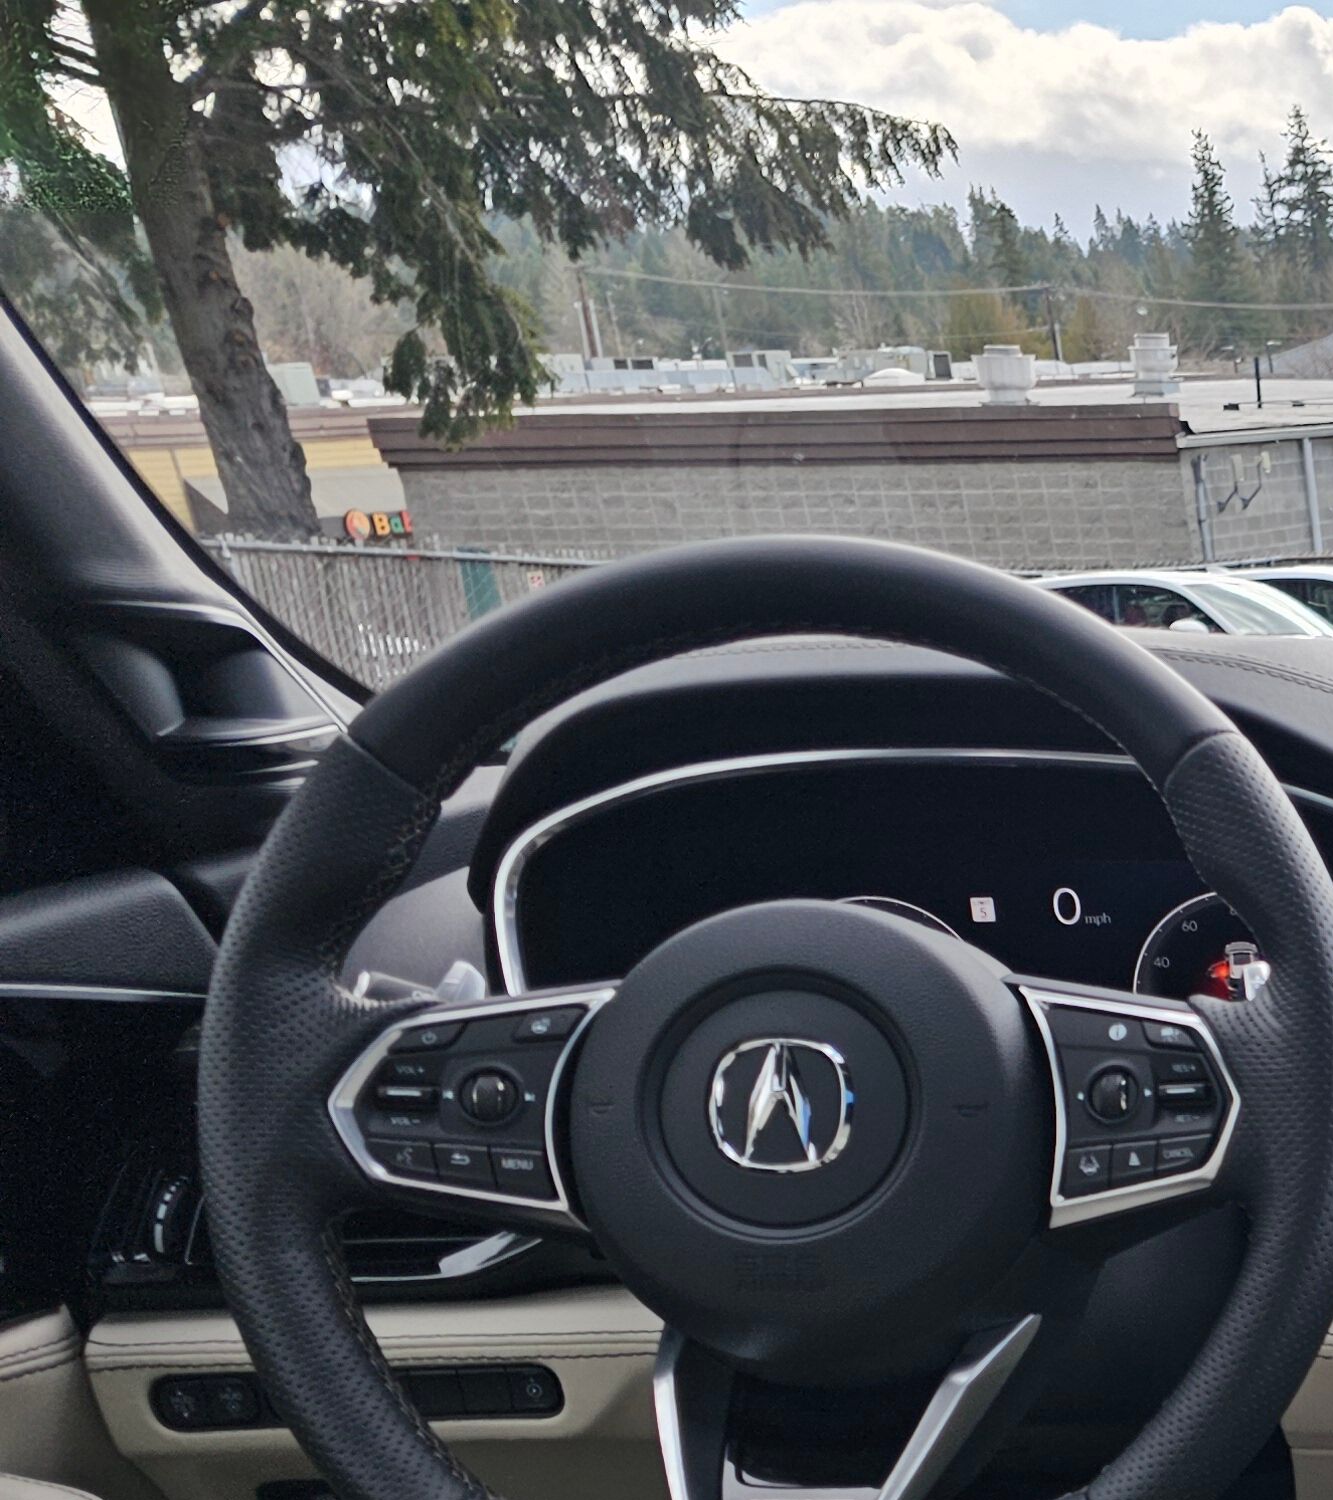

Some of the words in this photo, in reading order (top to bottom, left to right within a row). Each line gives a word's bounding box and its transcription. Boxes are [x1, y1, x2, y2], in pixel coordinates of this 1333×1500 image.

[1053, 888, 1081, 925] 0
[1084, 912, 1112, 926] mph
[1181, 920, 1198, 933] 60
[1153, 956, 1170, 969] 40
[502, 1157, 534, 1171] MENU
